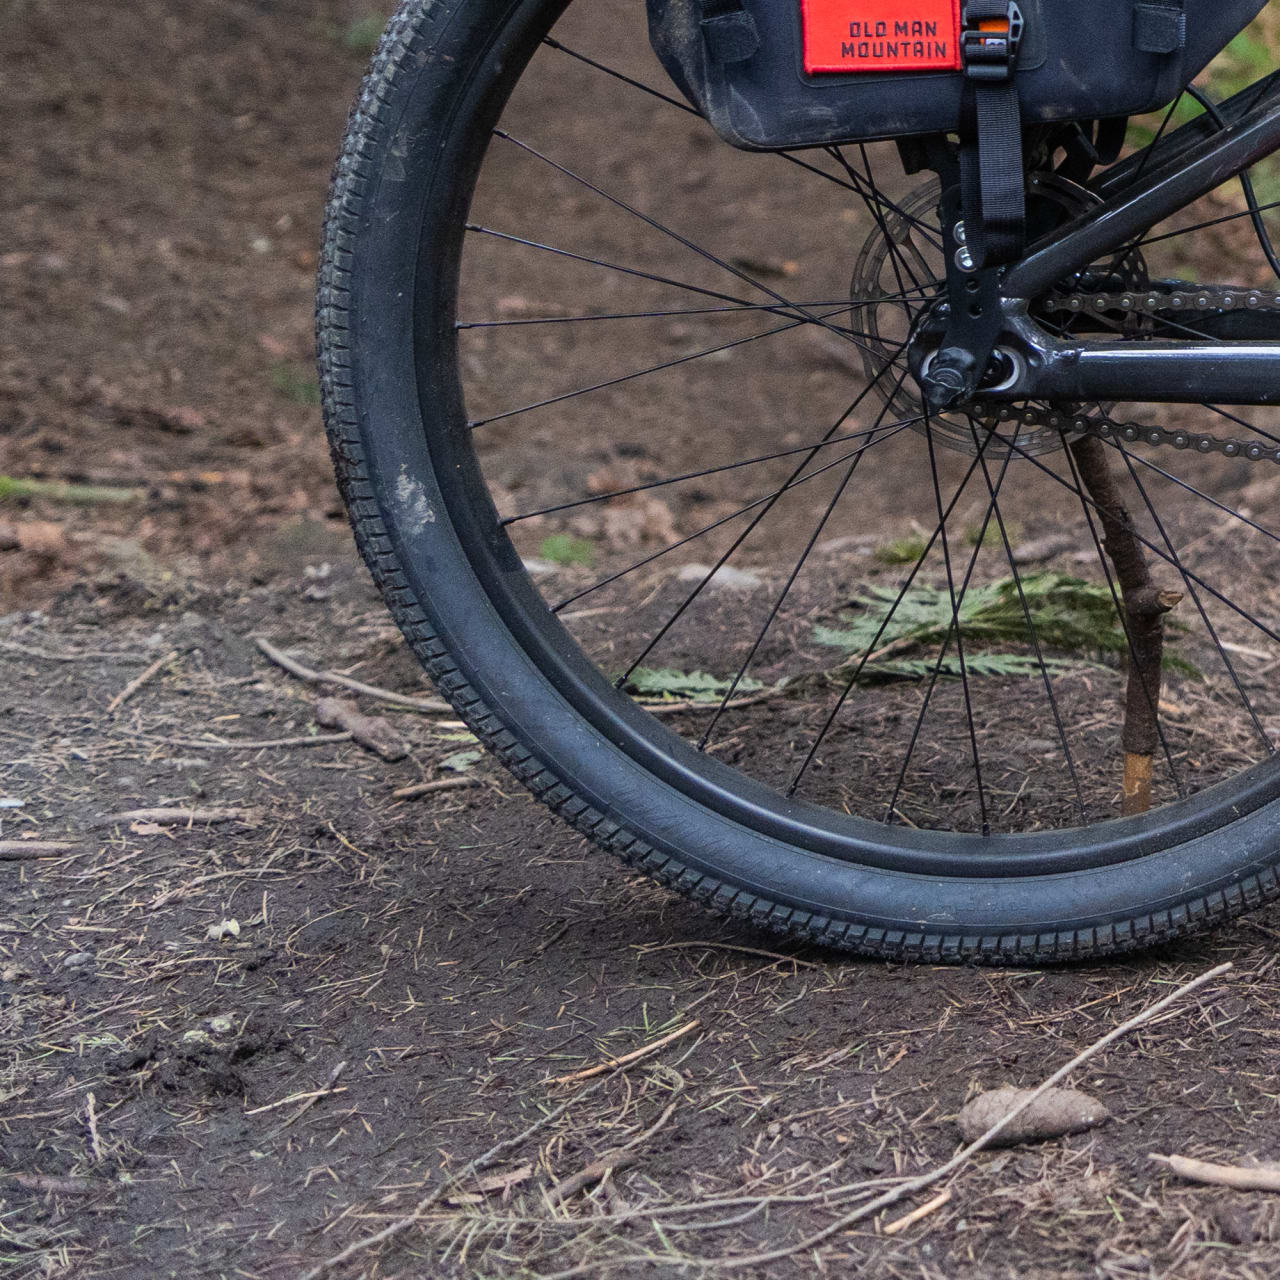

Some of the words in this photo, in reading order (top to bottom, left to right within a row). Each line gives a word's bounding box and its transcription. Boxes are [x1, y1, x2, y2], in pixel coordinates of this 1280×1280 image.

[849, 21, 887, 38] OLD
[894, 20, 937, 37] MAN
[841, 41, 946, 58] MOUNTAIN
